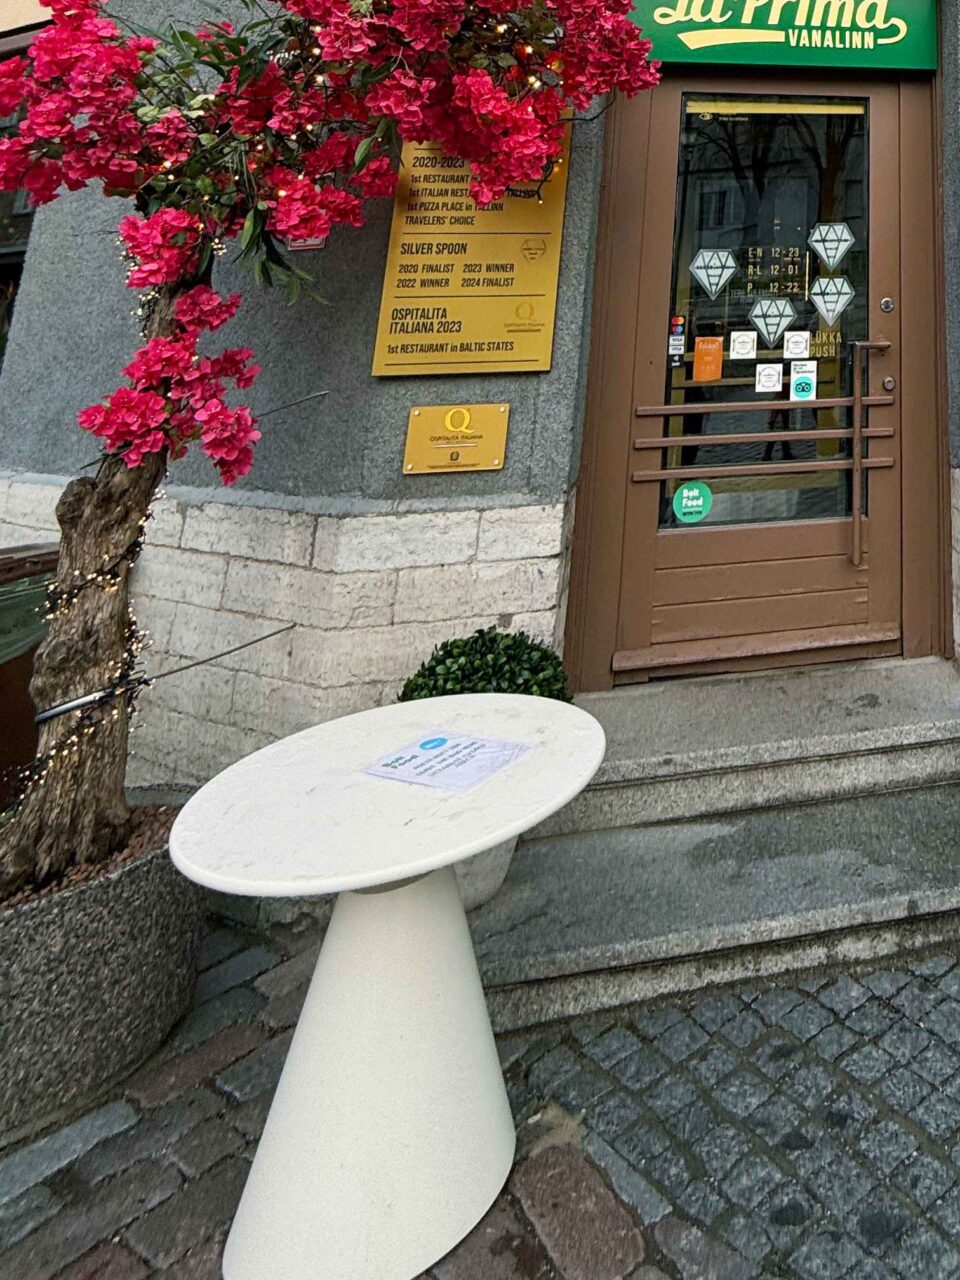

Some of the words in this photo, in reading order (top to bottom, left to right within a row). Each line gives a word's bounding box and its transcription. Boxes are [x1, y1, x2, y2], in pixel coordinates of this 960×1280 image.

[788, 29, 874, 49] VANALINN
[413, 156, 465, 168] 2020-2023
[423, 174, 469, 184] RESTAURANT
[420, 188, 449, 197] ITALIAN
[419, 202, 440, 211] PIZZA
[441, 202, 464, 211] PLACE
[449, 215, 476, 225] CHOICE
[400, 242, 433, 255] SILVER
[435, 242, 467, 254] SPOON
[399, 263, 418, 273] 2020
[421, 263, 455, 273] FINALIST
[463, 263, 482, 273] 2023
[486, 263, 514, 273] WINNER
[396, 278, 416, 288] 2022
[420, 278, 449, 288] WINNER
[461, 277, 481, 287] 2024
[482, 277, 515, 287] FINALIST
[391, 307, 447, 321] OSPITALITA
[389, 321, 434, 334] ITALIANA
[436, 320, 461, 333] 2023
[387, 344, 398, 354] 1st
[400, 342, 449, 353] RESTAURANT
[450, 342, 458, 352] in
[459, 342, 485, 353] BALTIC
[486, 341, 514, 351] STATES
[810, 345, 836, 358] PUSH
[682, 497, 704, 507] Food
